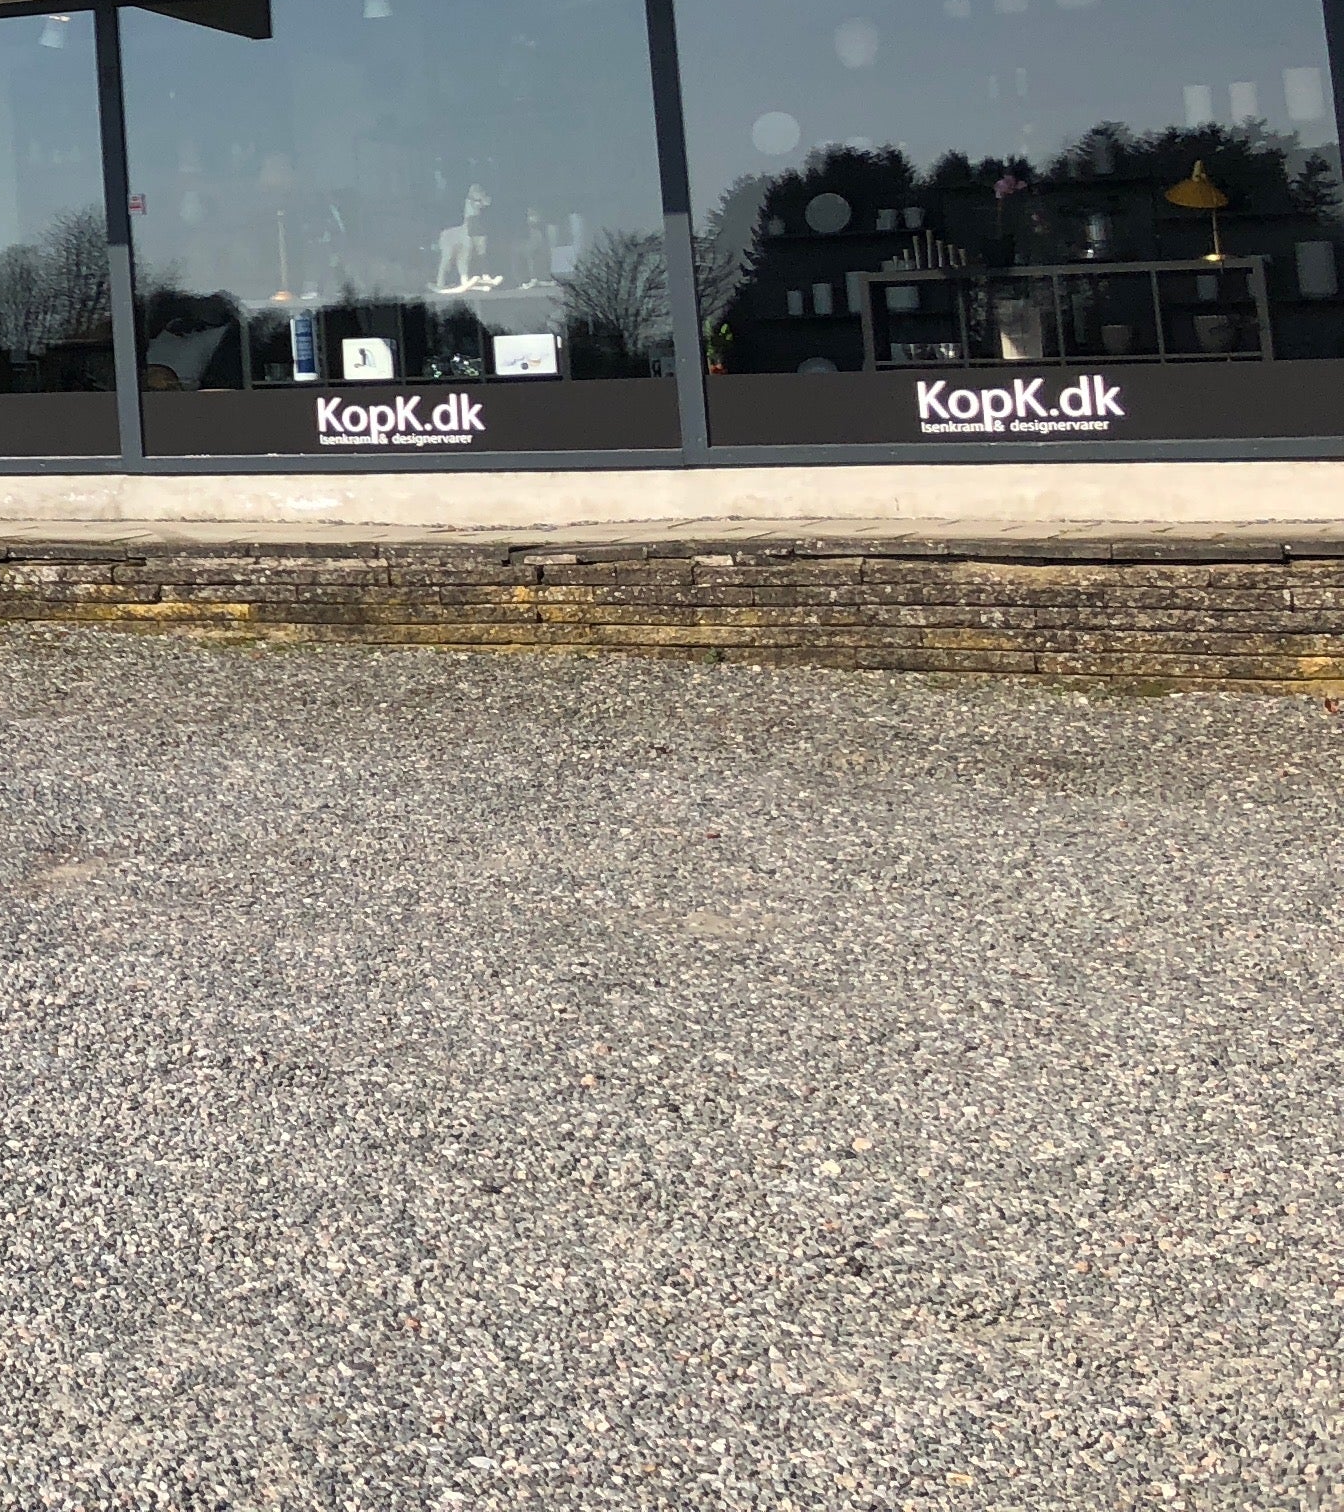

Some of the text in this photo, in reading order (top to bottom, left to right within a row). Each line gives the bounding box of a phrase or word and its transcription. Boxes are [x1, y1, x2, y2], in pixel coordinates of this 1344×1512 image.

[317, 393, 487, 444] KopK.dk
[917, 375, 1126, 432] KopK.dk
[379, 433, 389, 445] &
[392, 433, 473, 447] designervarer
[921, 420, 1110, 434] Isenkram & designervarer
